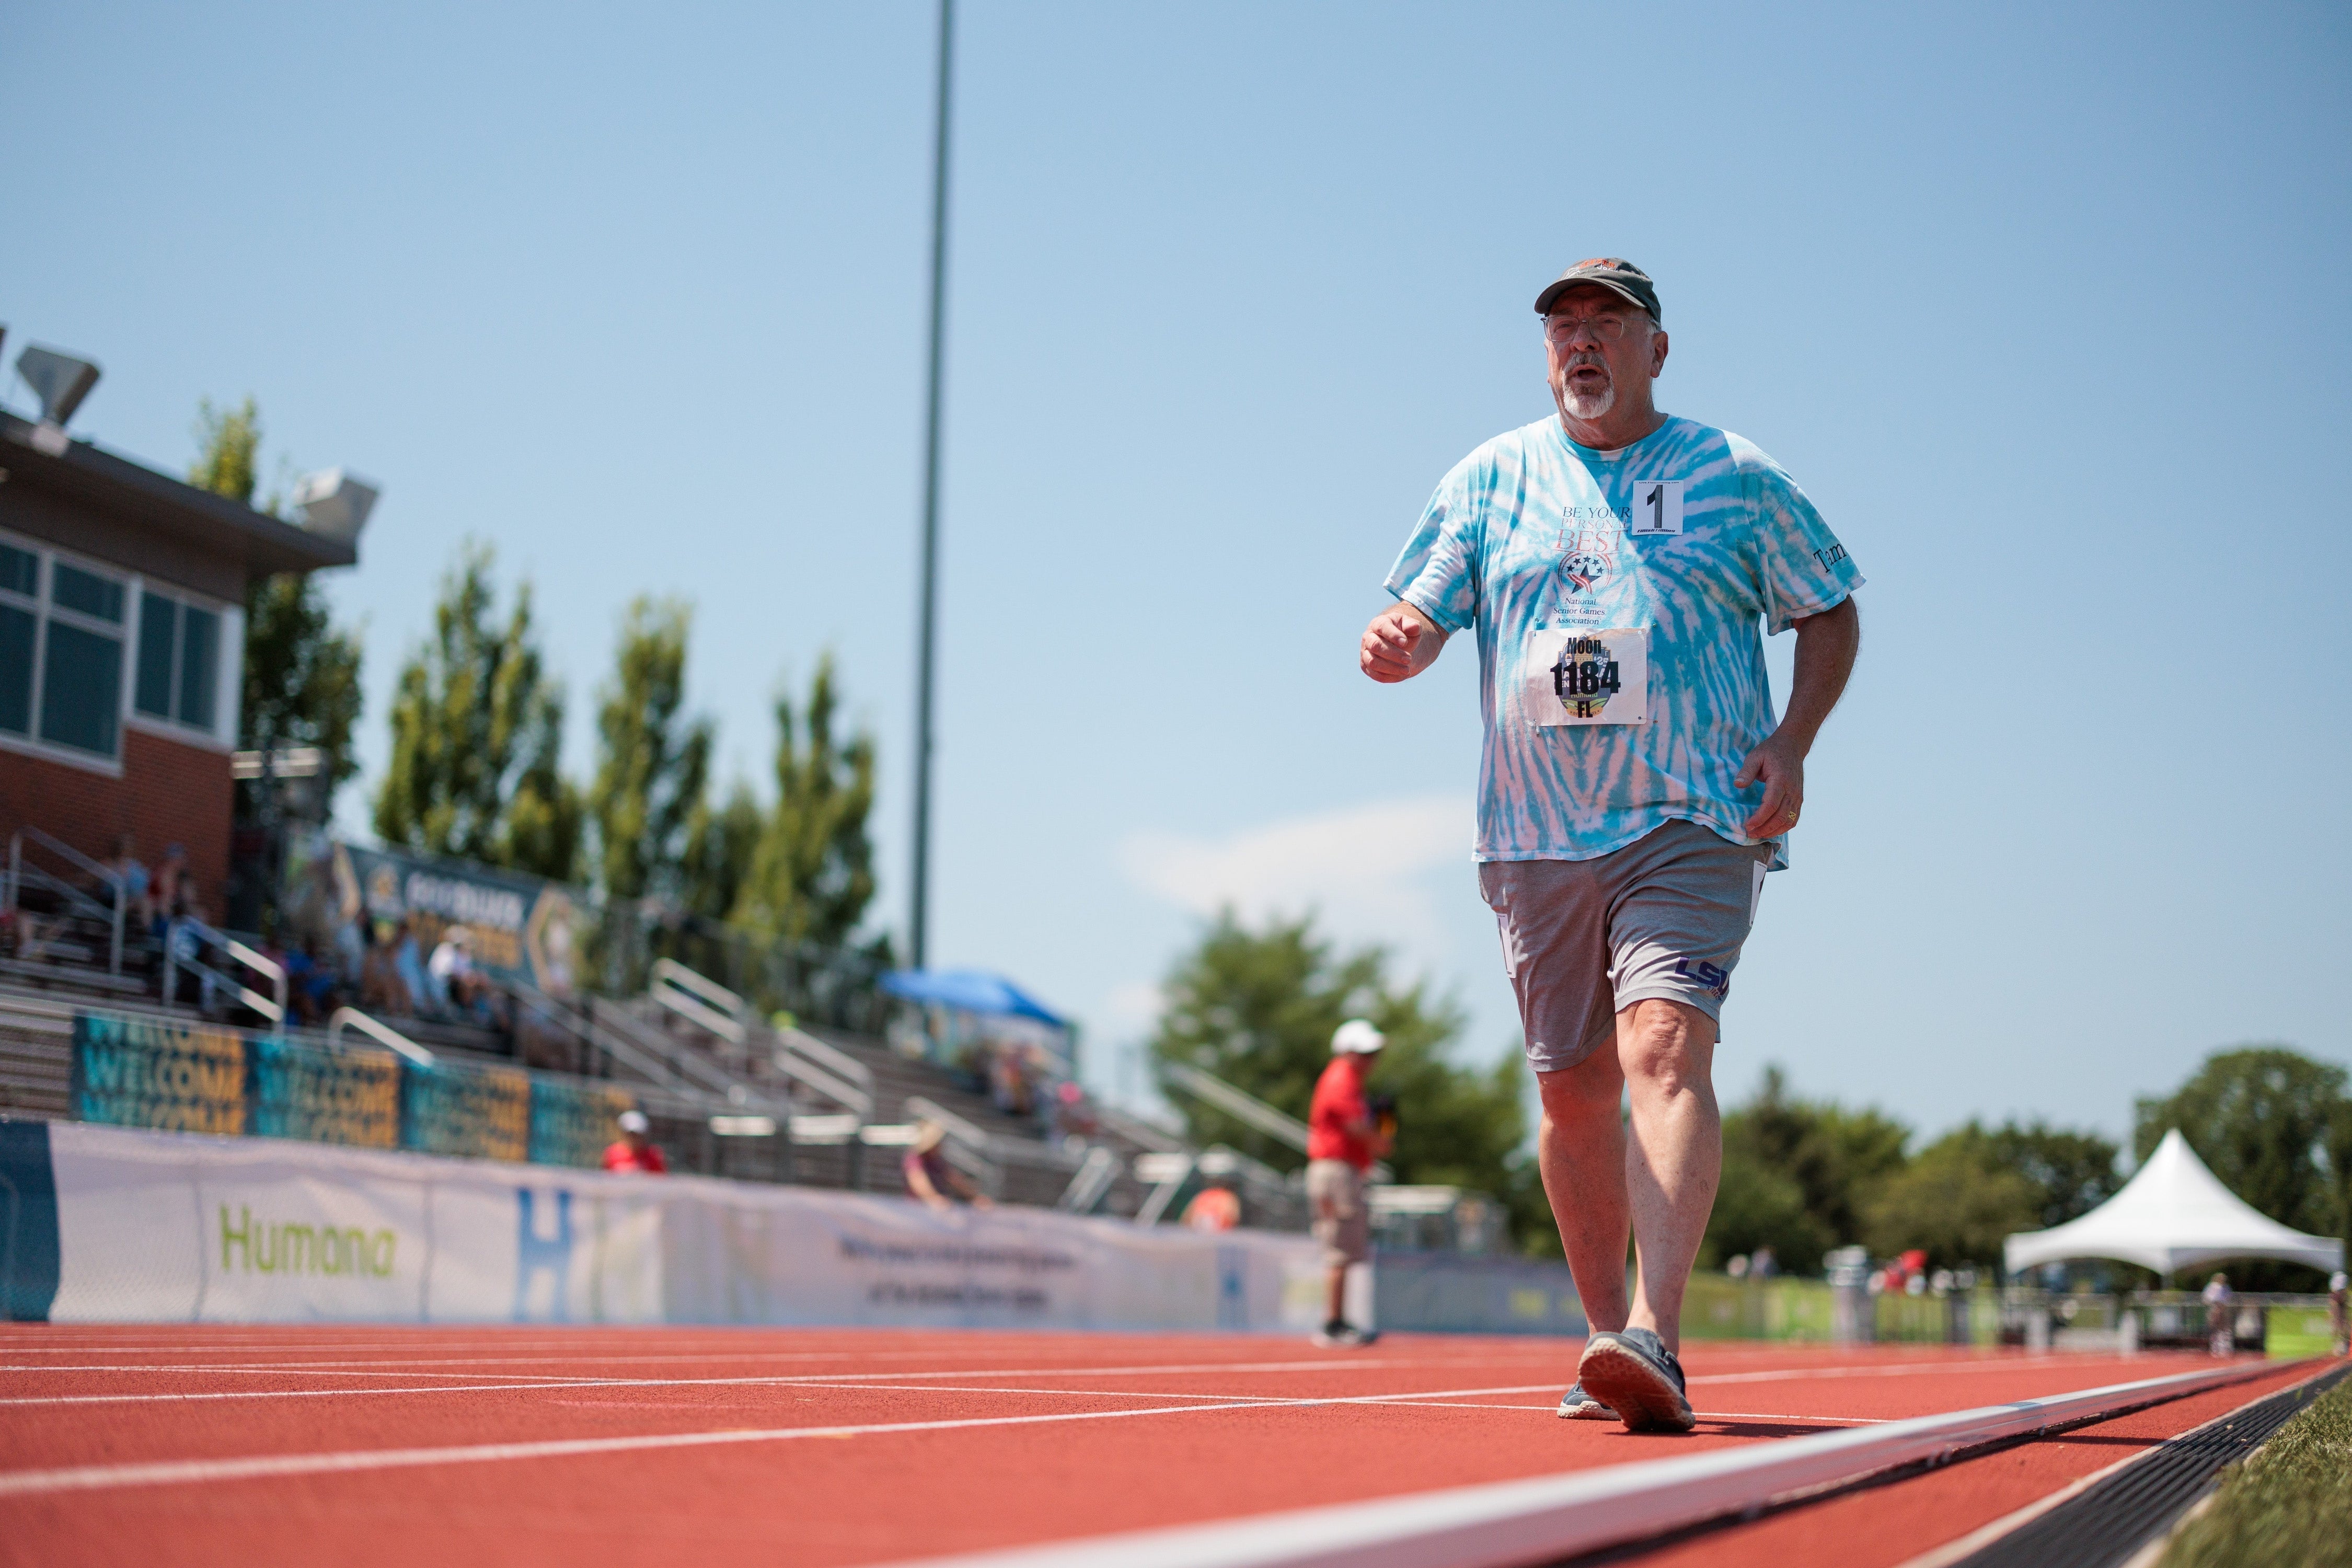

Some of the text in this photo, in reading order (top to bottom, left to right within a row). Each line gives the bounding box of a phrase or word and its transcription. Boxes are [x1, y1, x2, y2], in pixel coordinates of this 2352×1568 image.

[1563, 506, 1630, 518] BE YOUR
[1647, 485, 1663, 528] 1
[1562, 518, 1630, 529] PERSONAL
[1556, 529, 1628, 552] BEST
[1579, 607, 1605, 616] Games
[1567, 637, 1601, 654] Moon
[1550, 661, 1621, 696] 1184
[1577, 701, 1593, 718] FL
[1675, 956, 1730, 996] LSU
[218, 1204, 398, 1277] Humana
